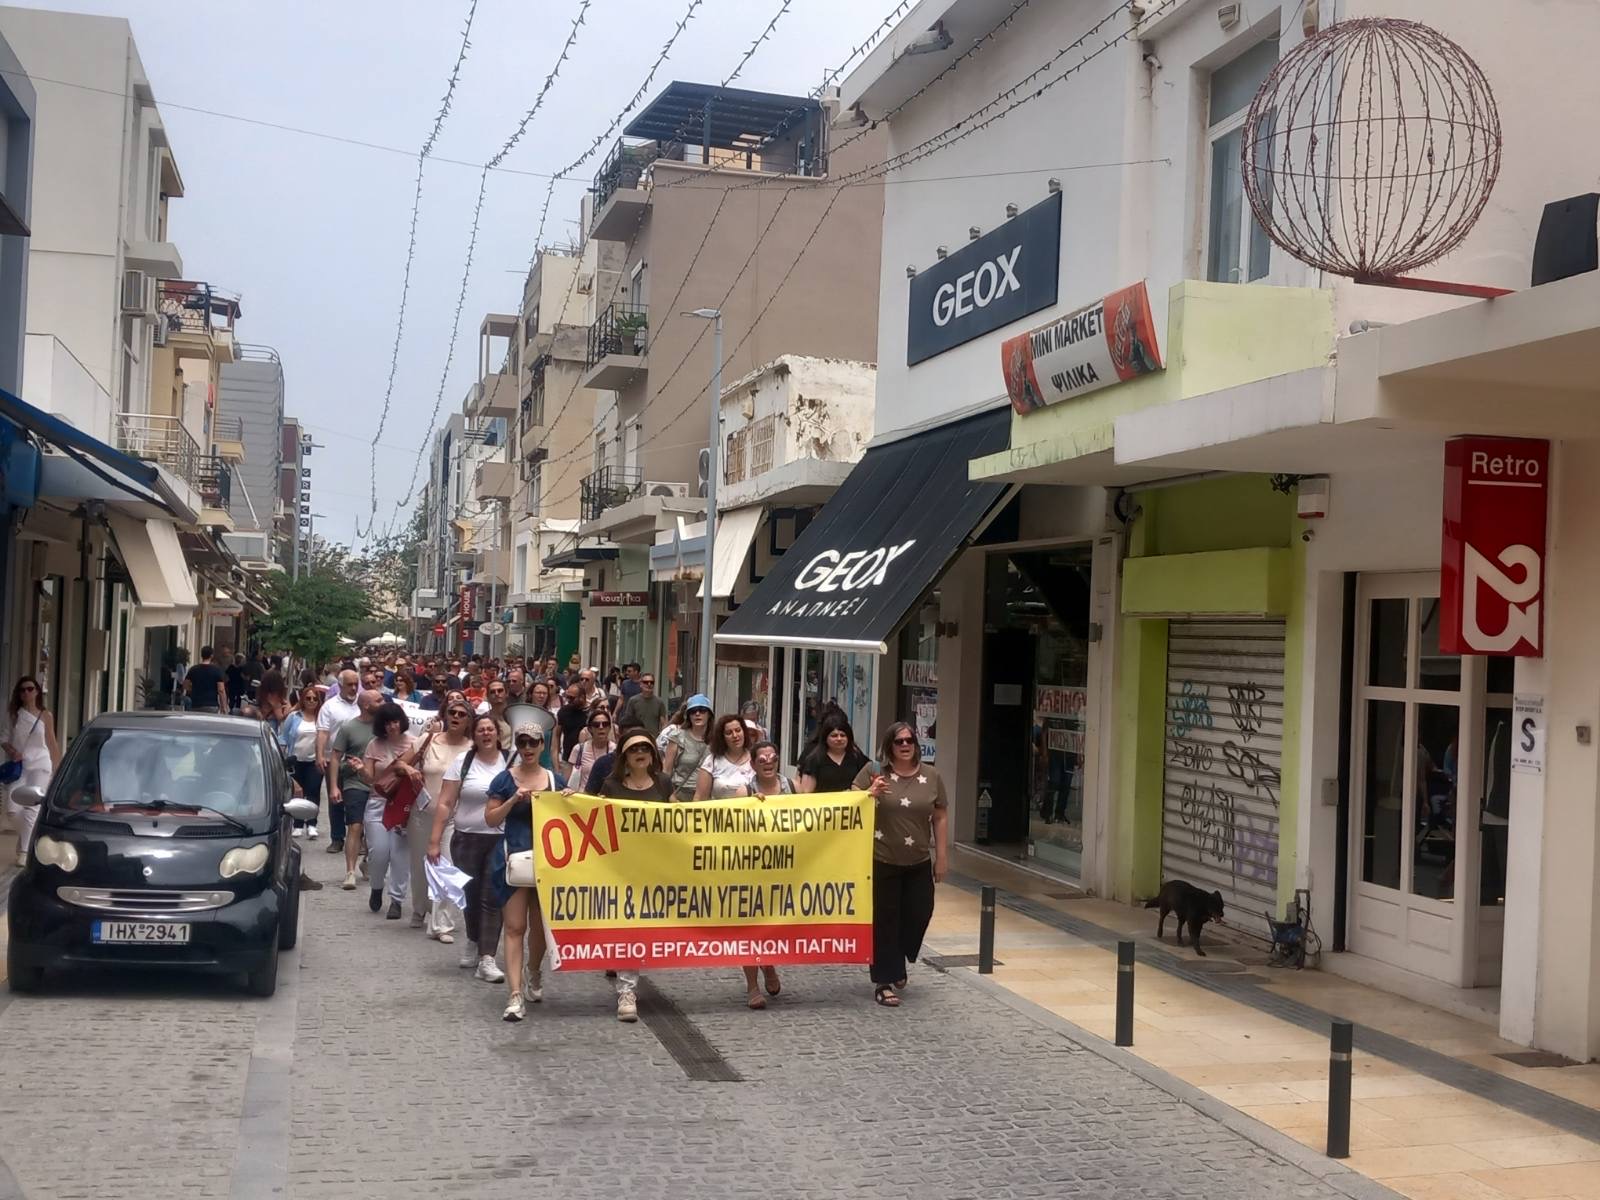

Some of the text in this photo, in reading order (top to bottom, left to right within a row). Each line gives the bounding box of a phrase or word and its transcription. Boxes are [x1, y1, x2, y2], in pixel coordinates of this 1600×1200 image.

[932, 245, 1022, 327] GEOX
[1030, 306, 1104, 361] MINI MARKET
[1051, 362, 1100, 393] ΨΙΛΙΚΑ
[1471, 451, 1540, 476] Retro
[794, 539, 917, 592] GEOX
[766, 597, 868, 617] ΑΝΑΠΝΕΕΙ
[1520, 717, 1537, 753] S
[541, 803, 620, 869] ΟΧΙ
[620, 805, 863, 834] ΣΤΑ ΑΠΟΓΕΥΜΑΤΙΝΑ ΧΕΙΡΟΥΡΓΕΙΑ
[693, 845, 794, 871] ΕΠΙ ΠΛΗΡΩΜΗ
[551, 882, 856, 921] ΙΣΟΤΙΜΗ & ΔΩΡΕΑΝ ΥΓΕΙΑ ΓΙΑ ΟΛΟΥΣ
[652, 940, 789, 958] ΕΡΓΑΖΟΜΕΝΩΝ
[795, 938, 857, 955] ΠΑΓΝΗ
